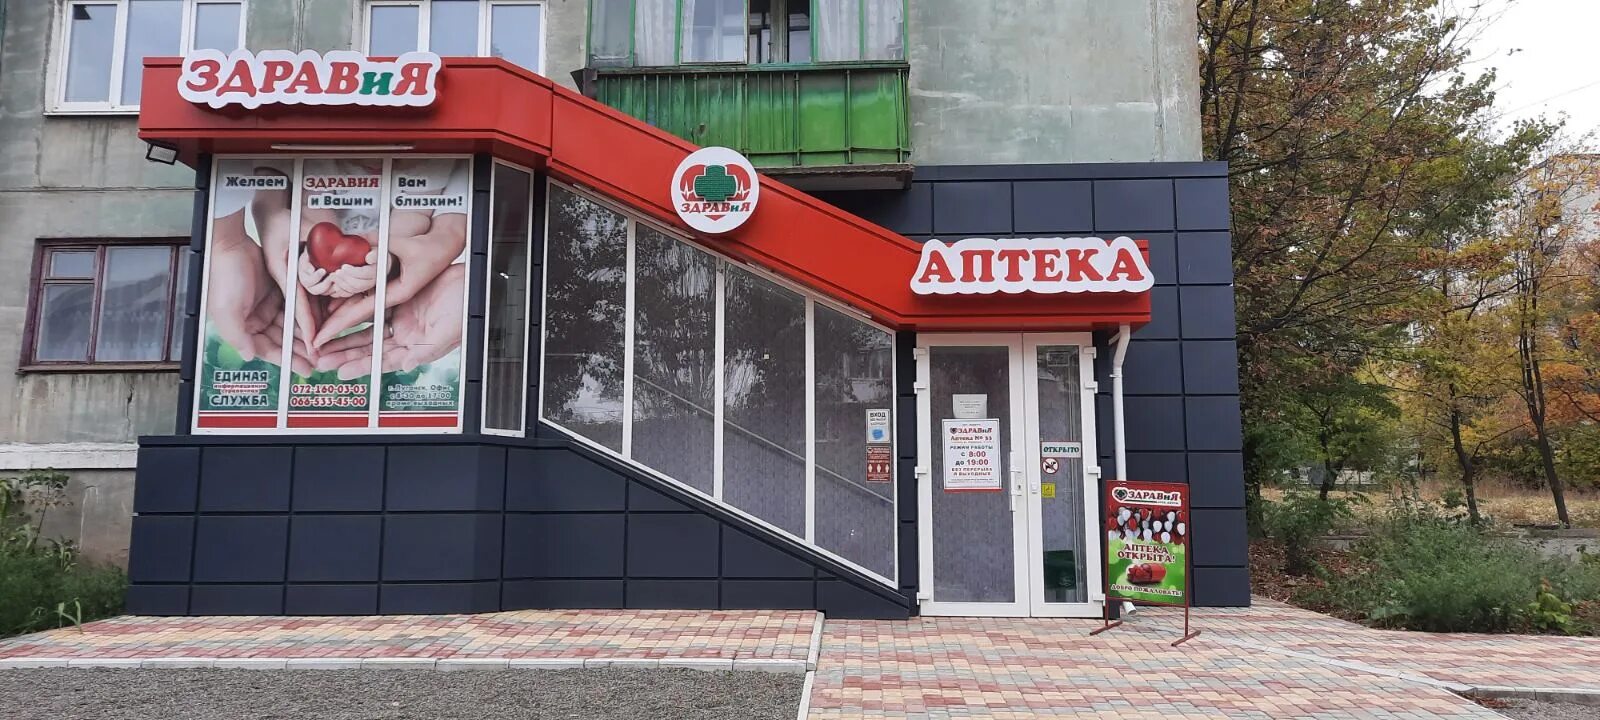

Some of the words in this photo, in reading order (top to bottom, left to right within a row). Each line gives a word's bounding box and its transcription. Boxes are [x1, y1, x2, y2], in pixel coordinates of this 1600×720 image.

[226, 176, 284, 187] Желаем
[306, 177, 379, 188] ЗДРАВИЯ
[398, 176, 426, 187] Вам
[311, 197, 319, 206] и
[324, 195, 373, 206] Вашим
[395, 195, 462, 206] близким!
[918, 248, 1145, 283] АПТЕКА
[214, 371, 268, 382] ЕДИНАЯ
[292, 384, 366, 394] 072-160-03-03
[210, 395, 268, 405] СЛУЖБА
[291, 397, 366, 406] 066-533-45-00
[1124, 544, 1169, 554] АПТЕКА
[1117, 551, 1176, 563] ОТКРЫТА!
